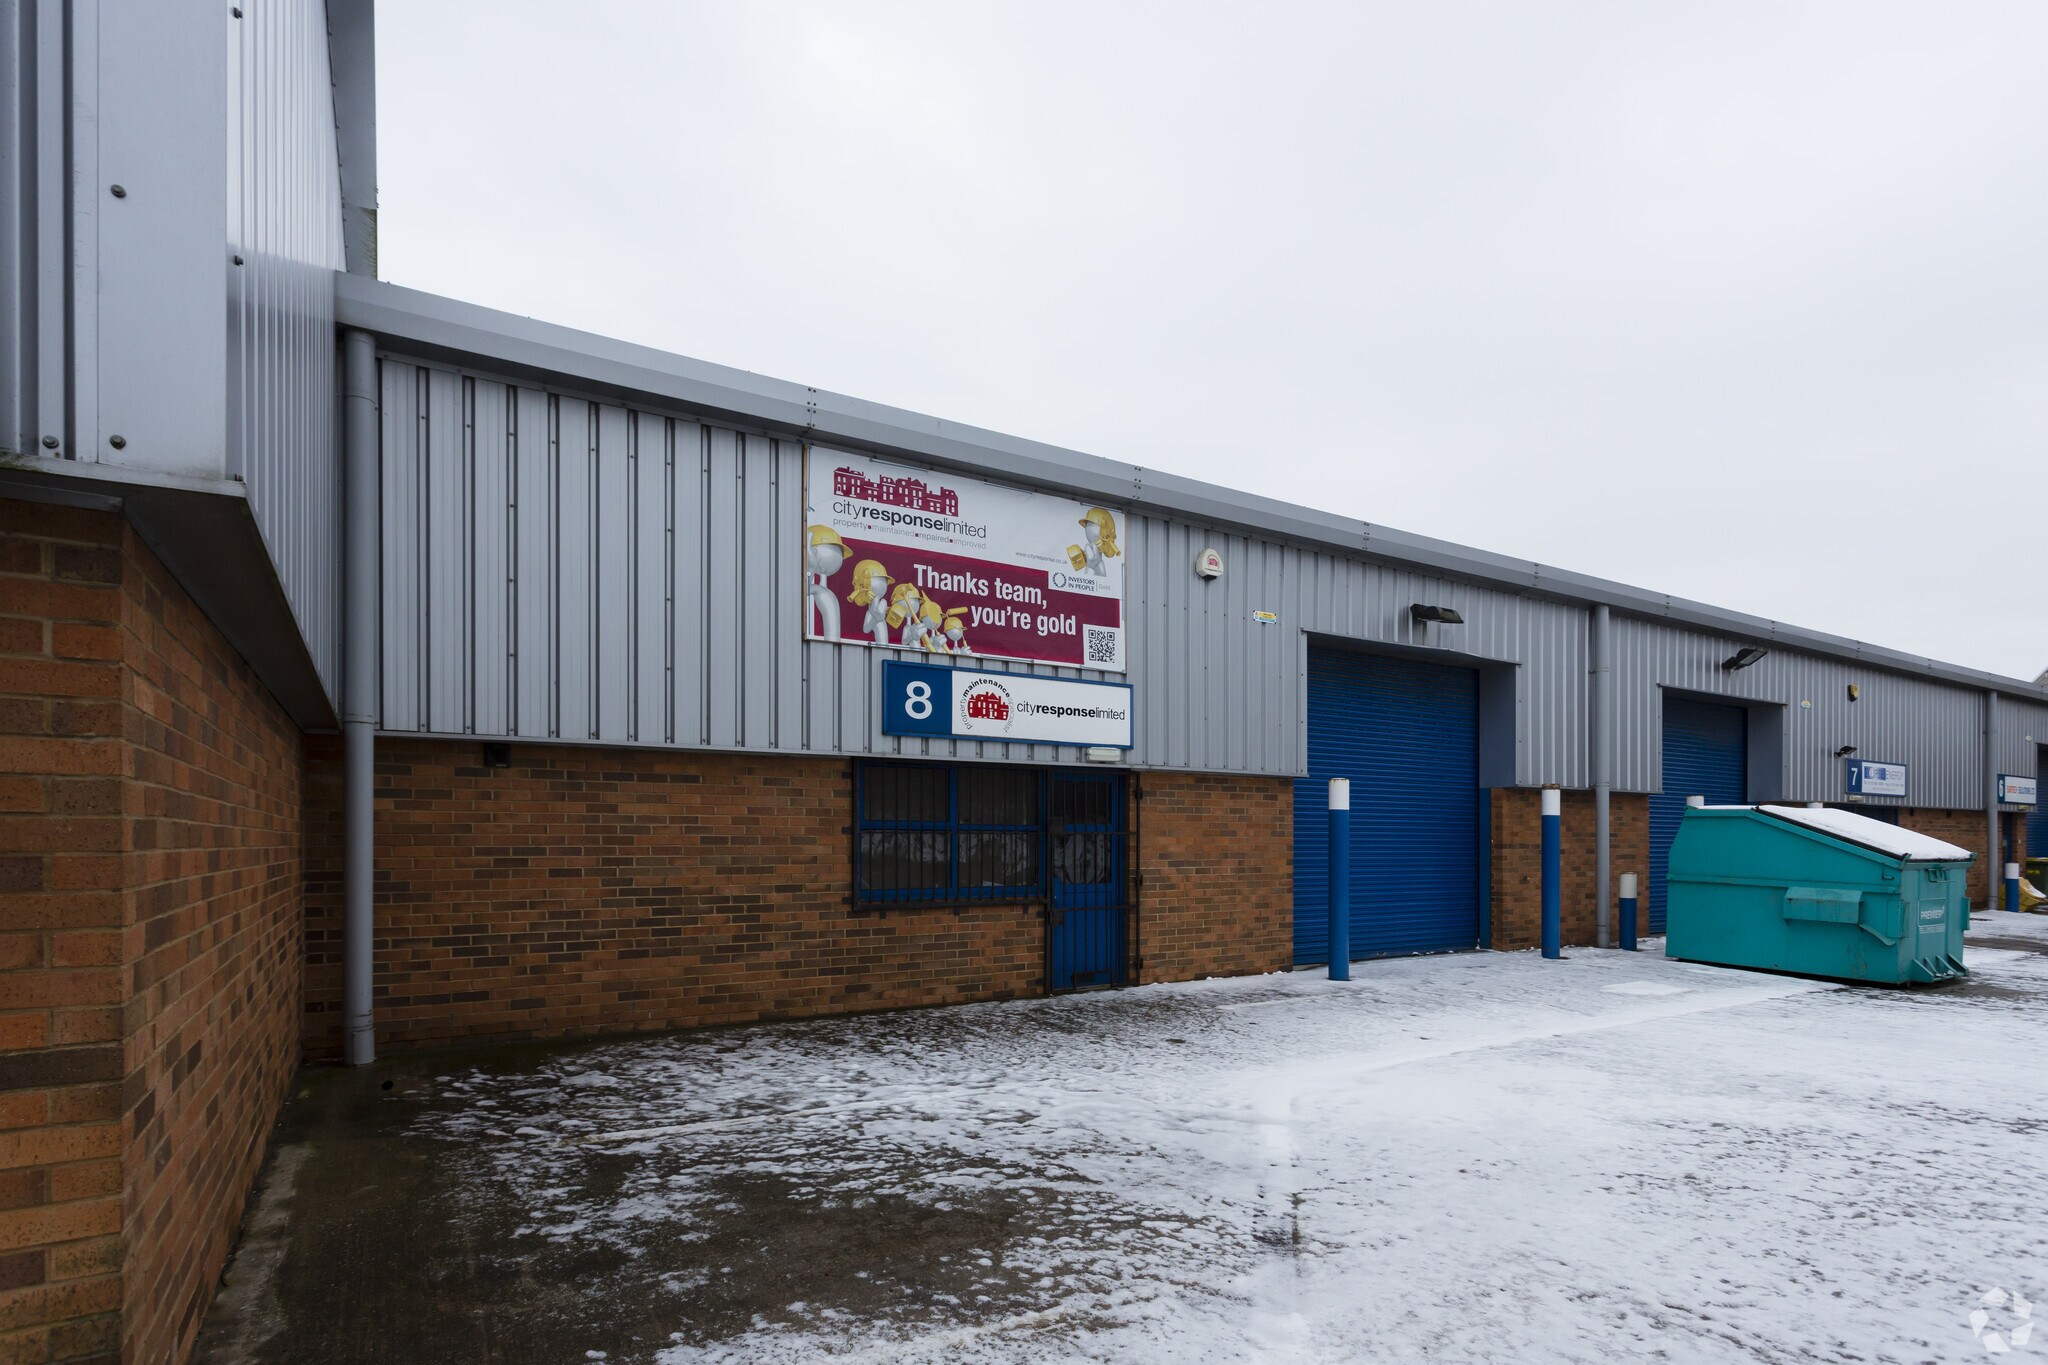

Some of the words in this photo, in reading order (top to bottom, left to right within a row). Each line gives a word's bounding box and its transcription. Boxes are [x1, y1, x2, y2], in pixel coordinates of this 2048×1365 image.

[833, 518, 867, 531] property
[872, 524, 918, 537] maintained
[919, 532, 949, 544] repaired
[954, 538, 987, 550] improved
[913, 563, 989, 597] Thanks
[994, 577, 1047, 610] team,
[1068, 576, 1095, 586] INVESTORS
[1075, 584, 1095, 592] PEOPLE
[1037, 613, 1077, 637] gold
[962, 678, 1011, 698] maintenance
[904, 680, 933, 720] 8
[1851, 767, 1858, 786] 7
[1998, 779, 2004, 797] 6
